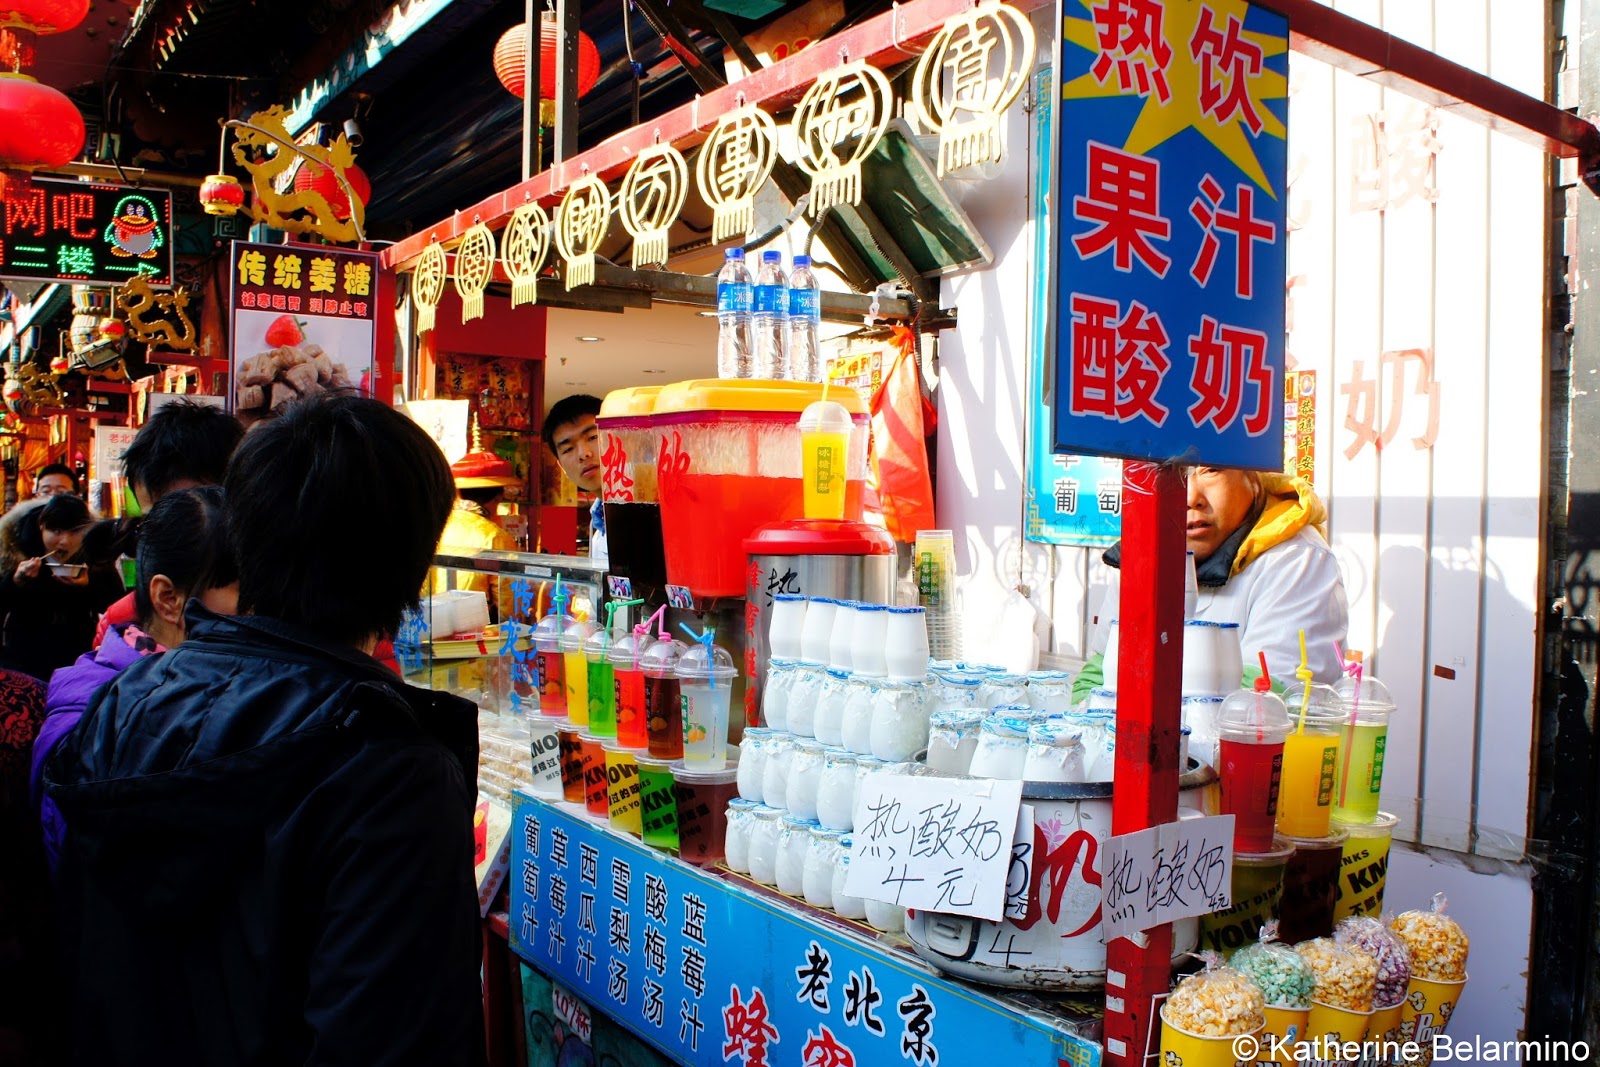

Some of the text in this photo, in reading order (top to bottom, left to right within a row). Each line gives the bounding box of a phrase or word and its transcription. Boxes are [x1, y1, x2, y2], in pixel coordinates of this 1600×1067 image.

[1091, 0, 1263, 136] 热饮
[5, 187, 97, 238] 网吧
[1072, 141, 1275, 299] 果汁
[11, 245, 95, 274] 二楼
[238, 250, 371, 295] 传统姜糖
[309, 298, 367, 316] 润肺止咳
[1070, 293, 1273, 437] 酸奶
[818, 448, 831, 492] 冰糖雪梨
[1055, 480, 1121, 514] 葡萄
[608, 764, 638, 787] OW
[609, 783, 640, 806] 过的味
[859, 794, 1001, 861] 热酸奶
[522, 814, 541, 945] 葡萄汁
[548, 827, 568, 963] 草莓汁
[576, 842, 598, 983] 西瓜汁
[1106, 838, 1225, 923] 热酸奶
[1213, 899, 1250, 919] FRUIT
[608, 857, 631, 1004] 雪梨汤
[642, 873, 667, 1028] 酸梅汤
[680, 892, 706, 1052] 蓝莓汁
[795, 940, 939, 1067] 老北京
